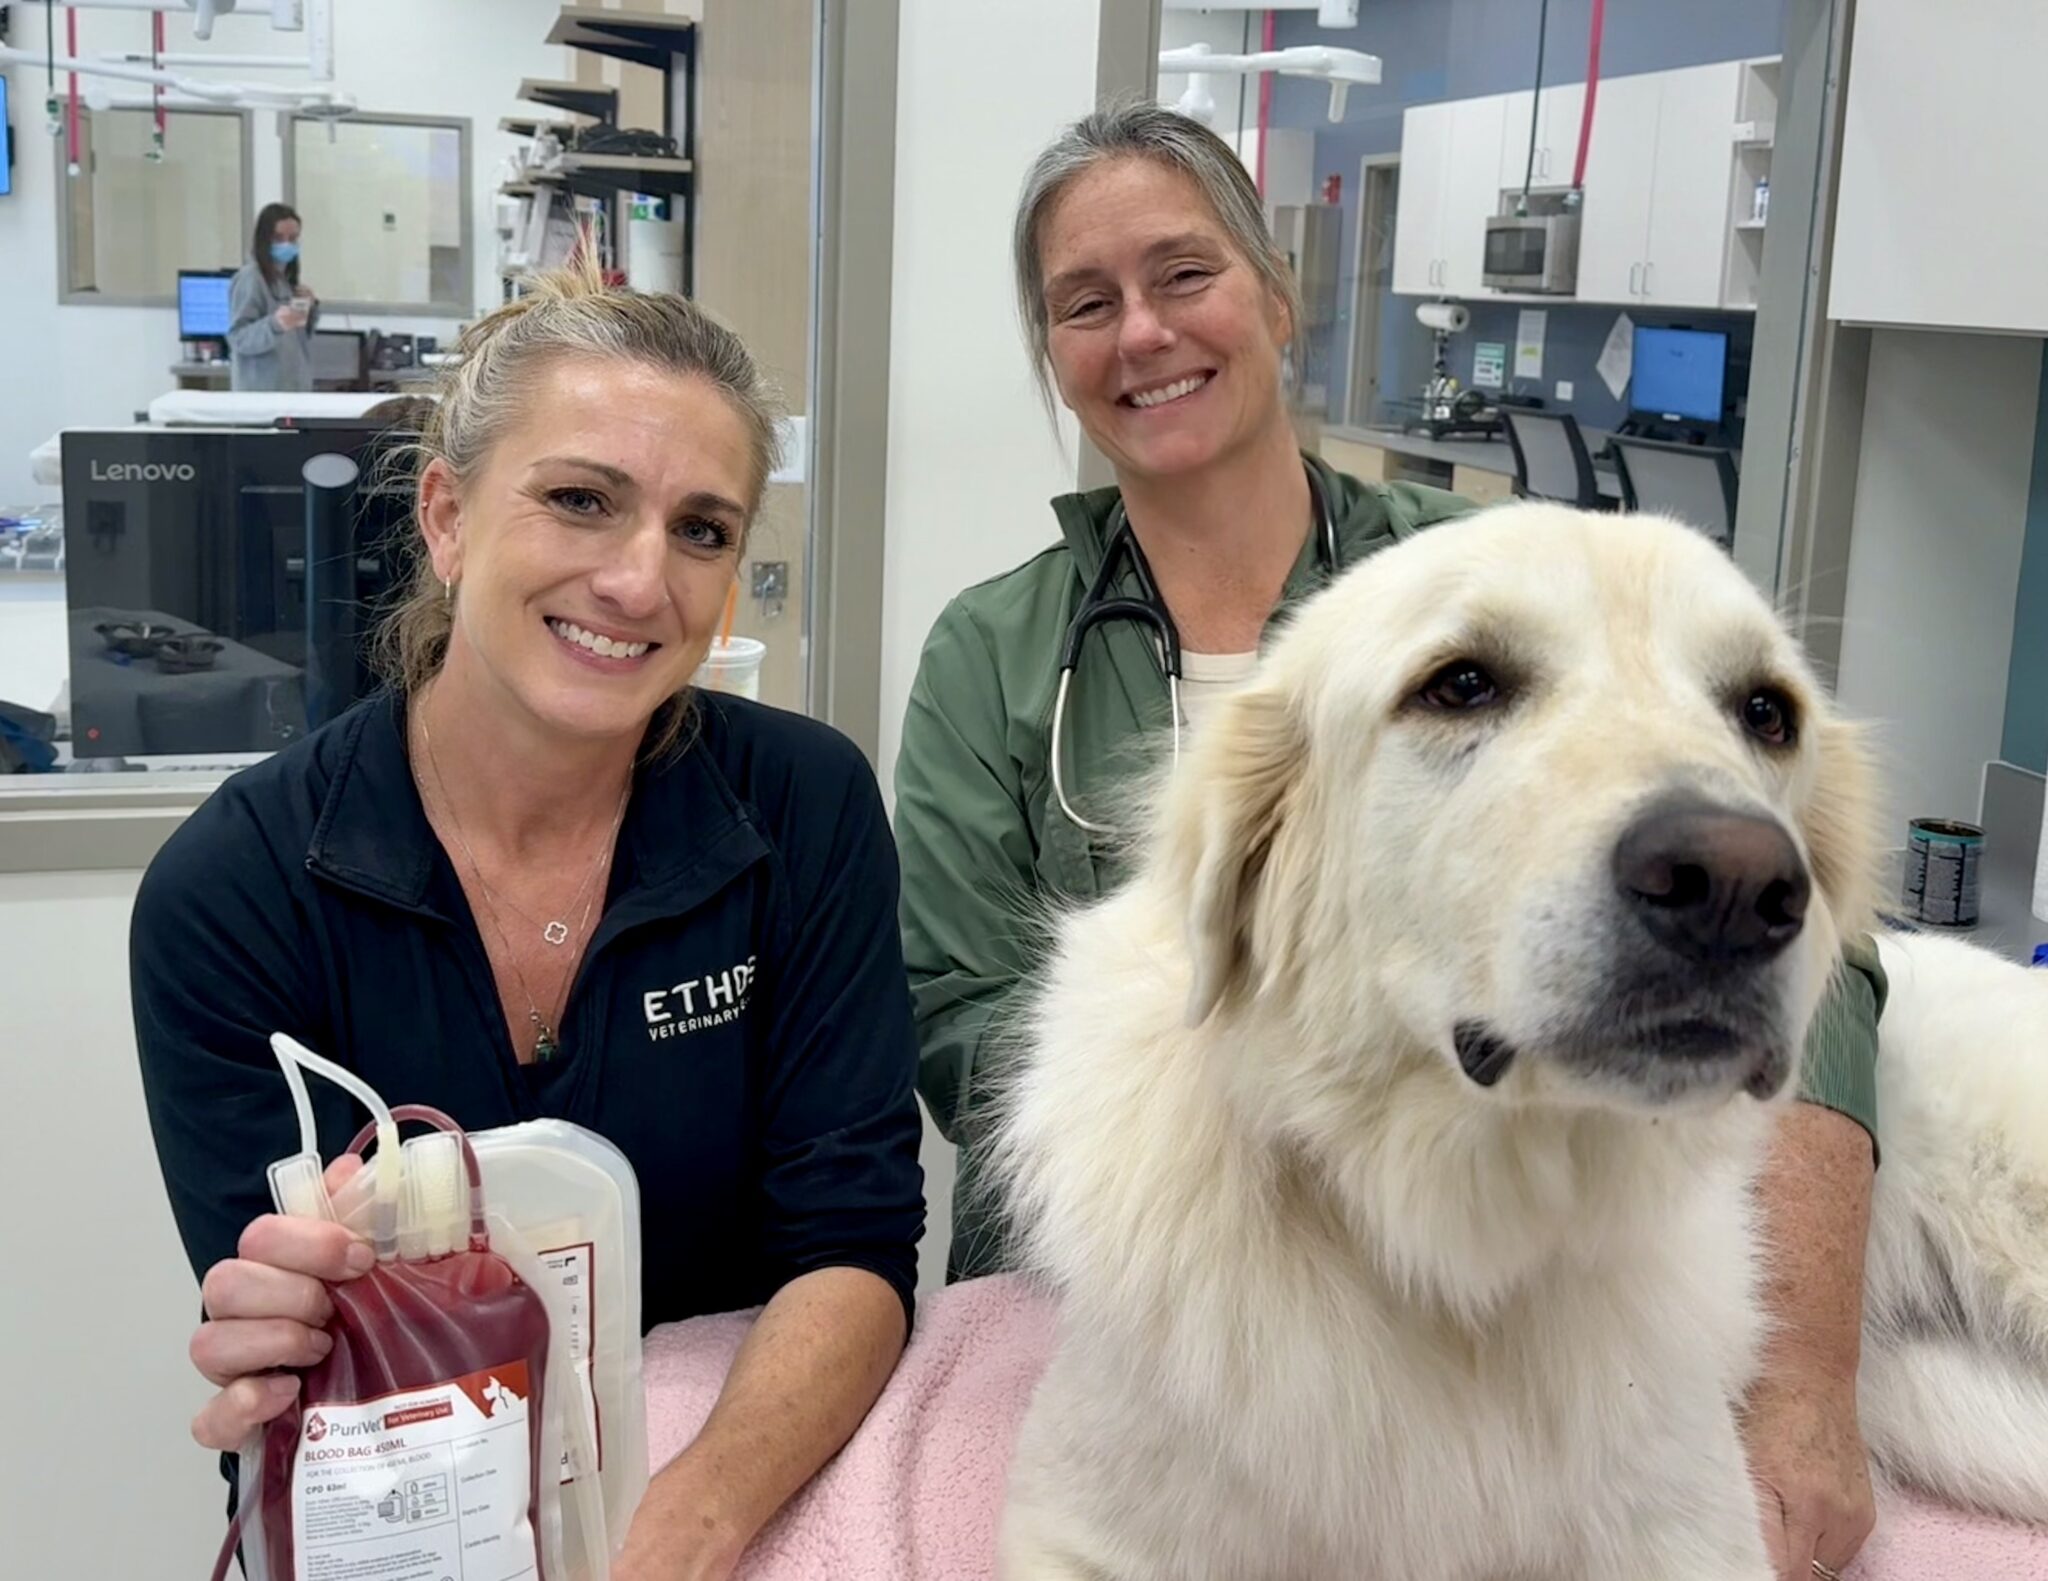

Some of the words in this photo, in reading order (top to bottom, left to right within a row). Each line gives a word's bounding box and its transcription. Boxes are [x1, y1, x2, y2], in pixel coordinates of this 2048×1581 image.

[91, 460, 195, 481] Lenovo
[648, 1006, 739, 1041] VETERINARY
[400, 1410, 434, 1422] Veterinary
[330, 1419, 380, 1436] PuriVet
[304, 1448, 344, 1462] BLOOD
[347, 1446, 372, 1458] BAG
[375, 1438, 407, 1454] 450ML
[305, 1484, 324, 1495] CPD
